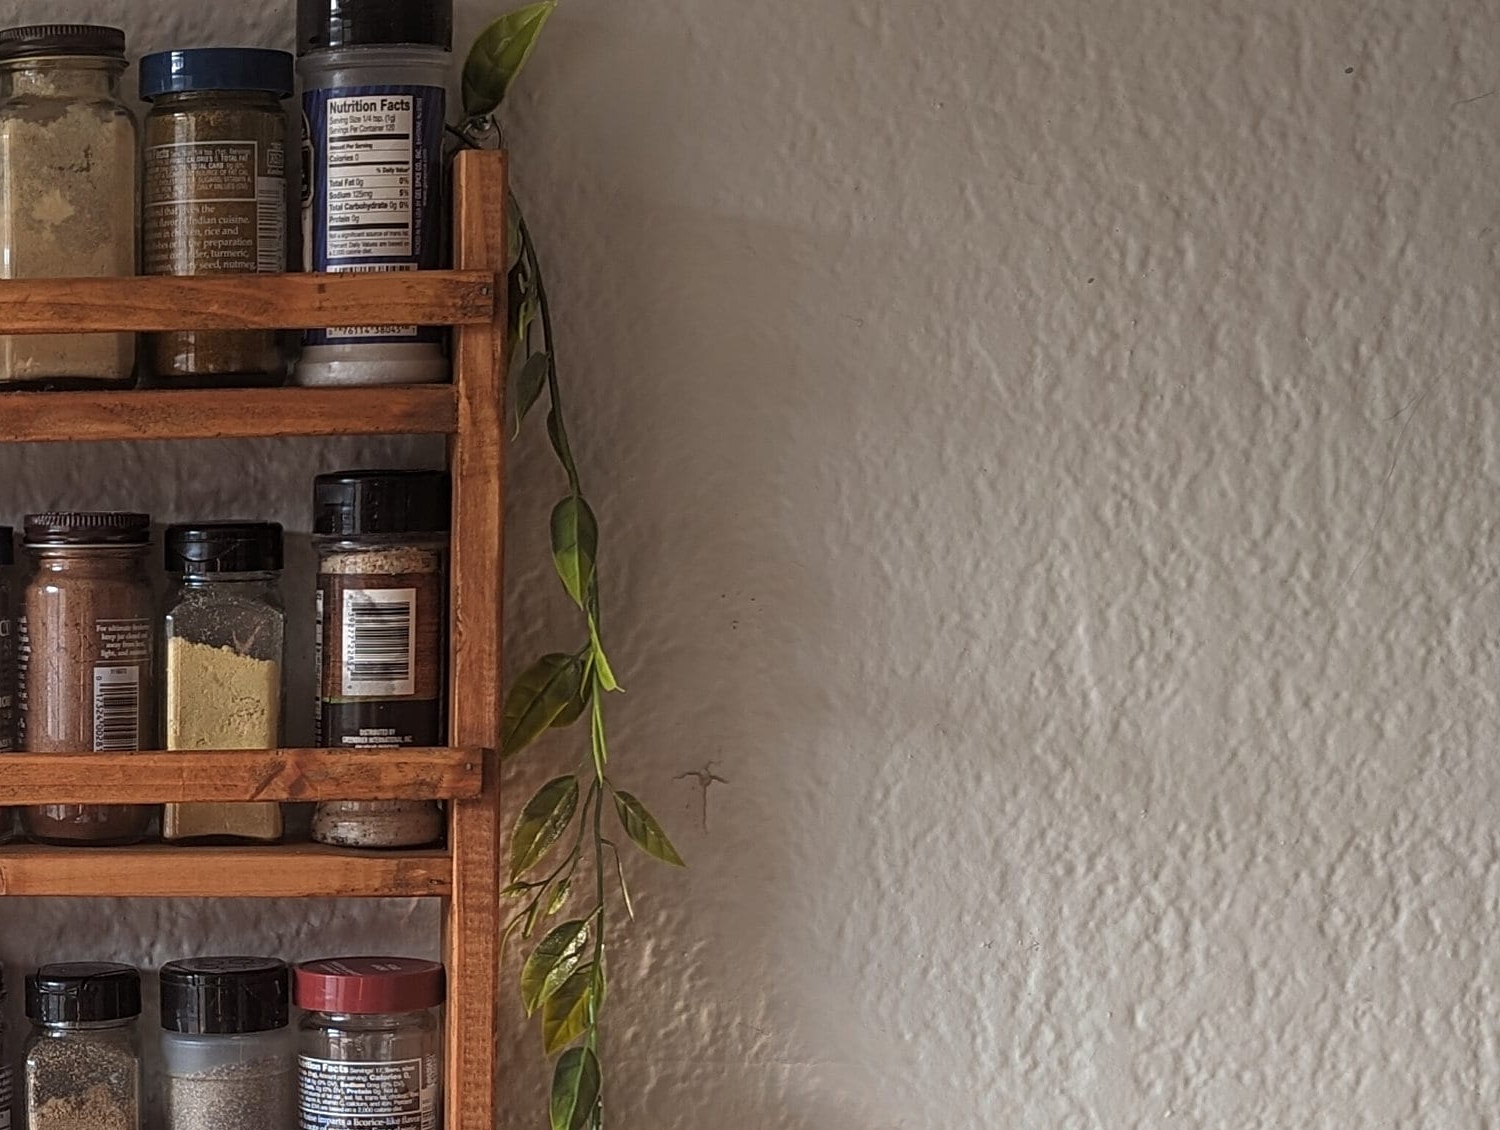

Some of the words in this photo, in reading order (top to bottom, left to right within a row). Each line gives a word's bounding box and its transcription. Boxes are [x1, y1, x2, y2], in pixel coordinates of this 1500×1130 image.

[329, 100, 377, 114] Nutrition
[380, 99, 411, 112] Facts
[329, 179, 343, 187] Total
[344, 179, 355, 187] Fat
[329, 192, 351, 200] Sodium
[329, 203, 343, 211] Total
[344, 201, 388, 211] Carbohydrate
[218, 215, 251, 224] cuisine.
[204, 227, 221, 236] rice
[222, 226, 239, 236] and
[204, 238, 253, 248] preparation
[211, 249, 250, 259] turmeric,
[322, 1063, 349, 1073] Facts
[369, 1073, 402, 1081] Calories
[353, 1116, 401, 1127] licorice-like
